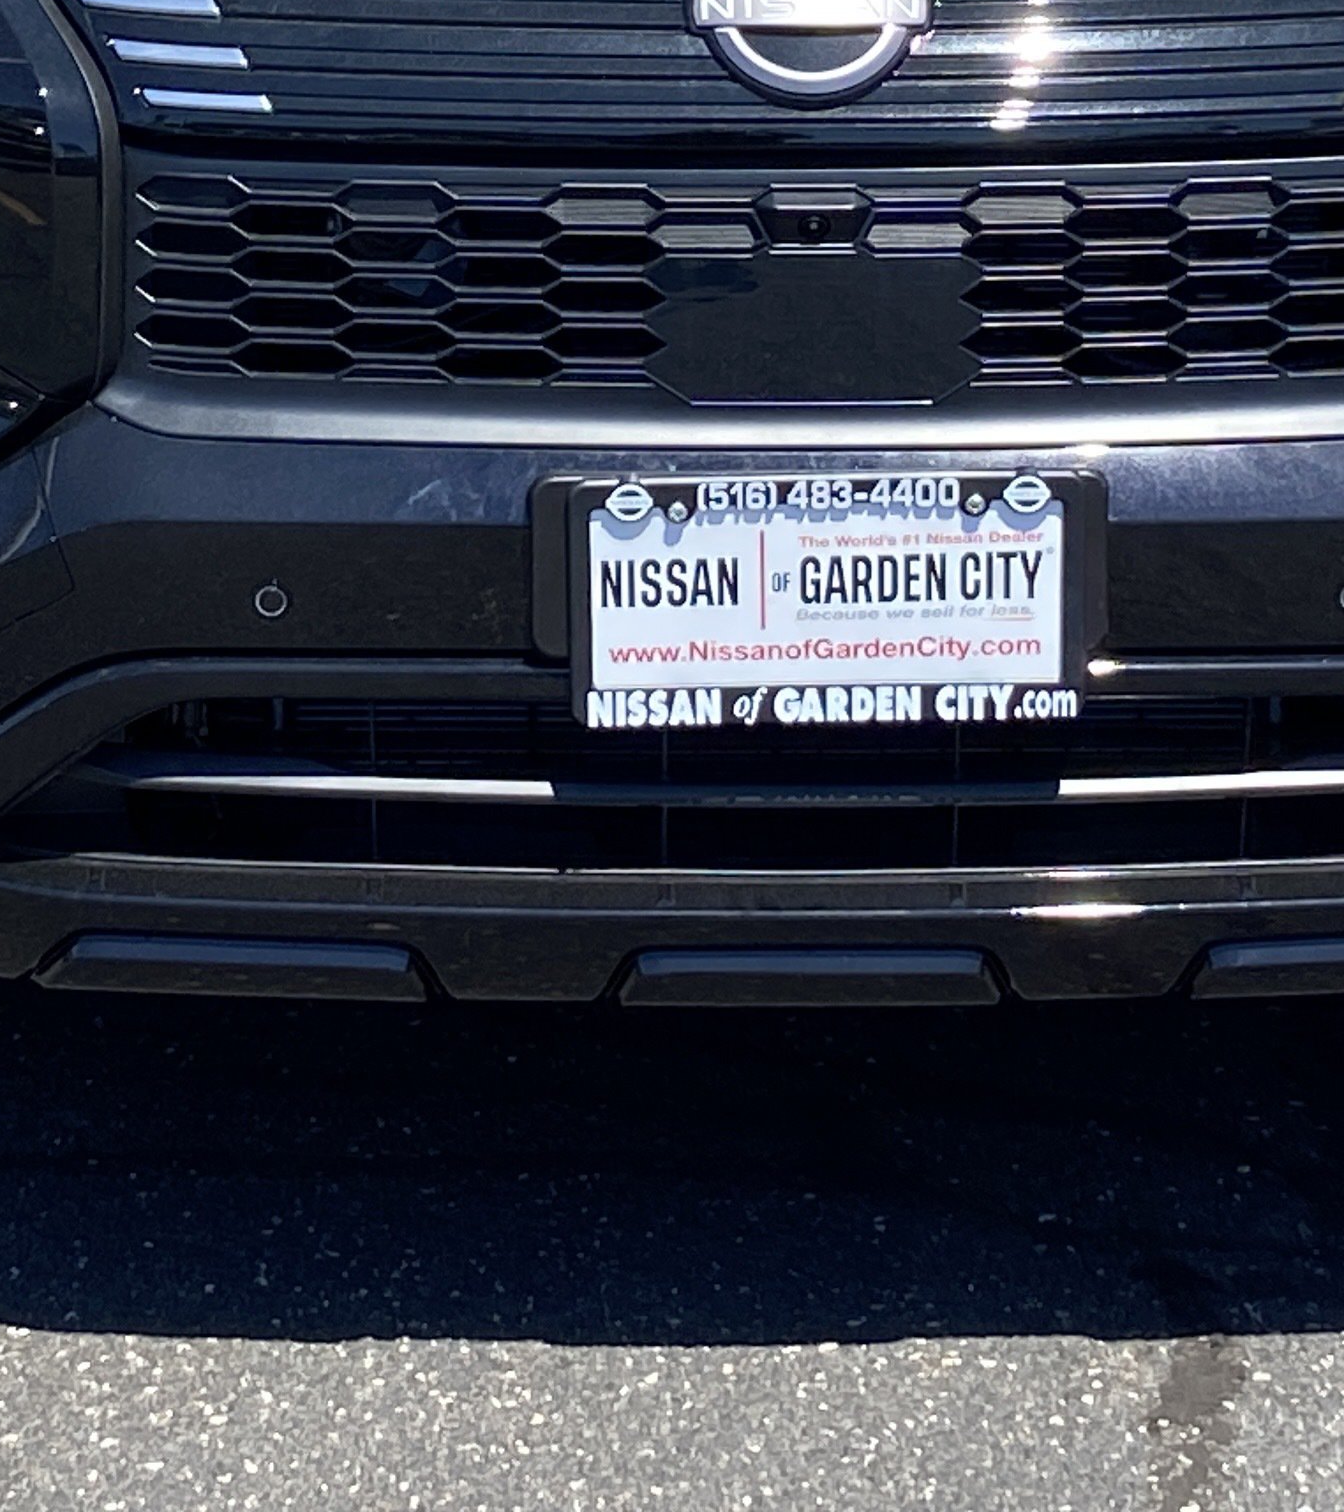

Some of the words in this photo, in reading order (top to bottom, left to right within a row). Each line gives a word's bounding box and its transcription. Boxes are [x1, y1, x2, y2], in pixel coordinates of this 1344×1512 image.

[696, 481, 778, 512] (516)
[787, 477, 960, 510] 483-4400
[798, 535, 829, 548] The
[833, 533, 897, 548] World's
[902, 533, 920, 546] #1
[926, 532, 984, 545] Nissan
[989, 530, 1044, 543] Dealer
[599, 556, 739, 609] NISSAN
[771, 571, 791, 593] OF
[799, 553, 948, 605] GARDEN
[959, 550, 1043, 602] CITY
[796, 609, 879, 622] Because
[886, 608, 914, 619] we
[920, 605, 954, 618] sell
[959, 604, 985, 618] for
[608, 636, 1041, 665] www.NissanofGardenCity.com
[587, 689, 723, 729] NISSAN
[733, 686, 769, 727] of
[773, 685, 922, 725] GARDEN
[935, 685, 1077, 722] CITY.com
